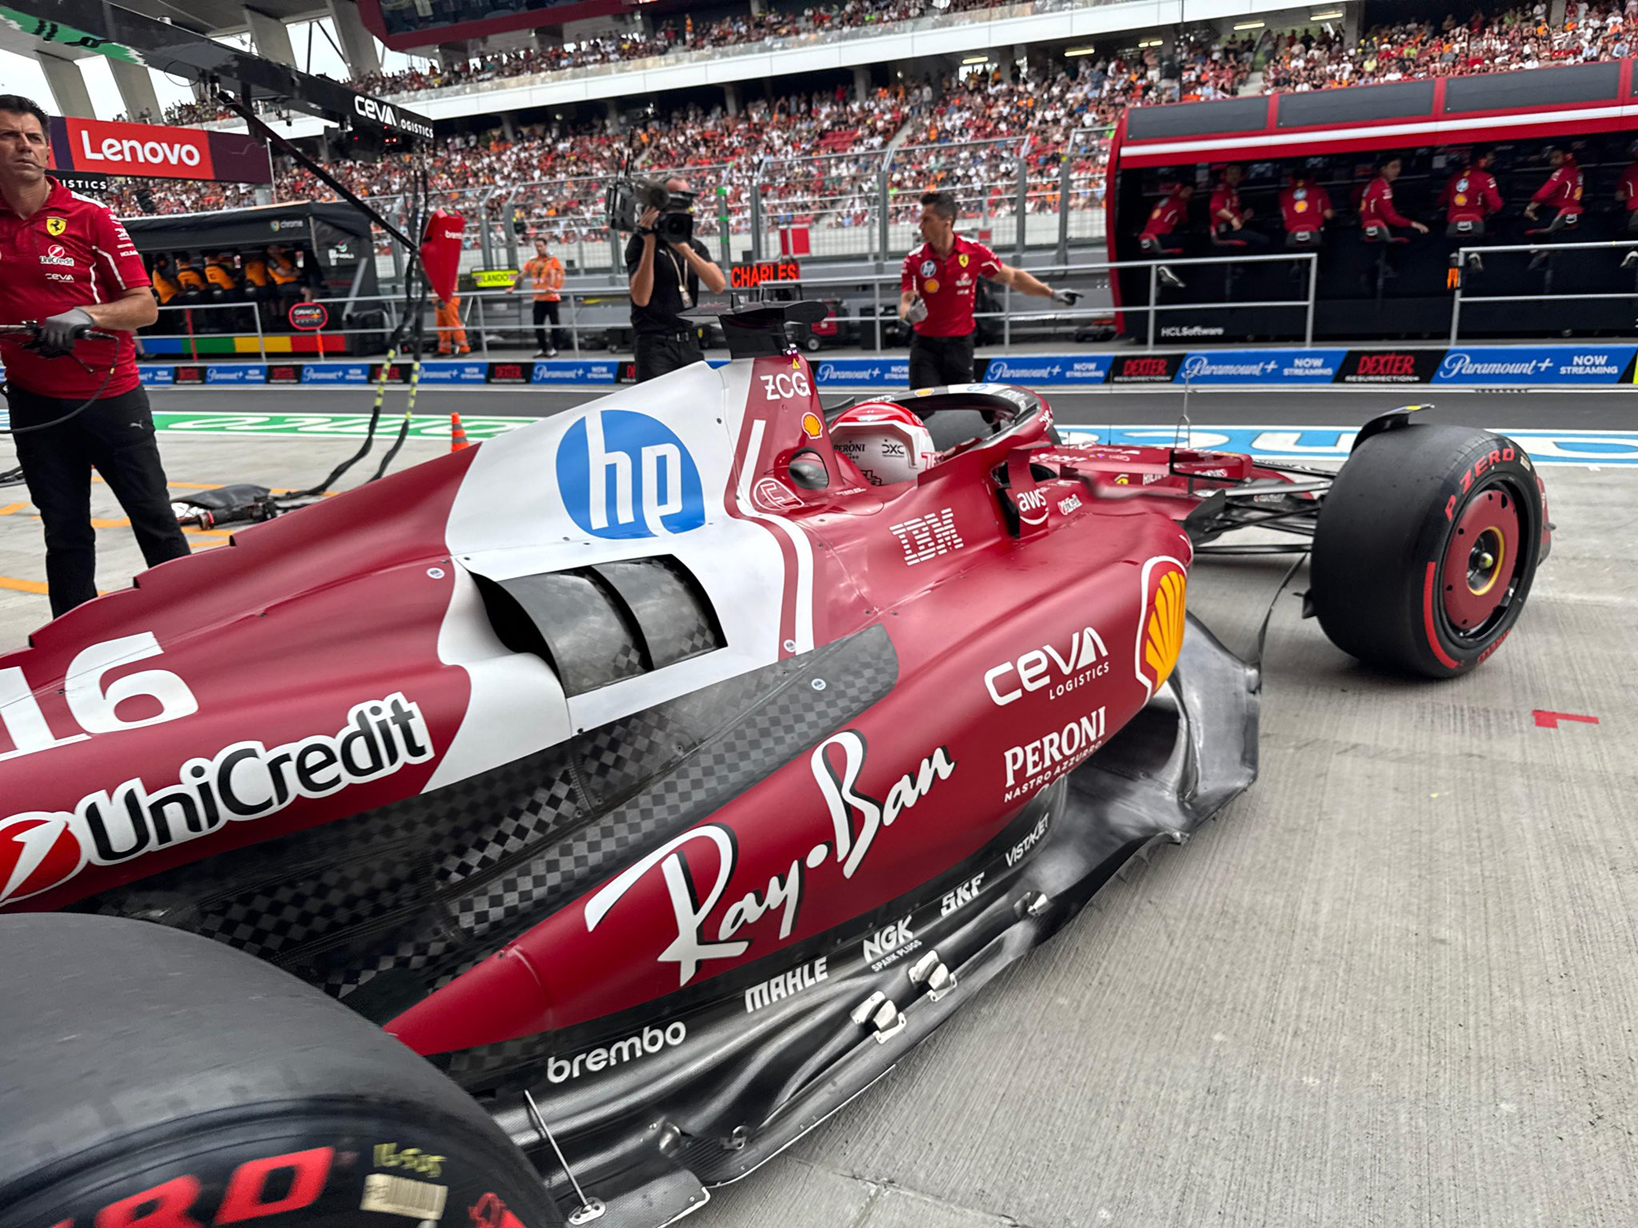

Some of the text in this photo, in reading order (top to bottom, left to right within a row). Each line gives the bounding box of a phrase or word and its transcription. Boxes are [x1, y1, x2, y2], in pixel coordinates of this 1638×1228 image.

[400, 119, 434, 138] OGISTICS
[81, 130, 200, 166] Lenovo
[60, 179, 107, 189] ISTICS
[482, 274, 509, 283] LANDO
[730, 263, 798, 288] CHARLES
[1161, 326, 1224, 337] HCLSoftware
[987, 361, 1062, 382] Paramount+
[1073, 362, 1097, 371] NOW
[1123, 358, 1167, 376] DEXTER
[1181, 355, 1278, 379] Paramount+
[1282, 367, 1333, 376] STREAMING
[1294, 358, 1324, 367] NOW
[1357, 352, 1415, 375] DEXTER
[1439, 353, 1554, 379] Paramount+
[1559, 366, 1618, 375] STREAMING
[1572, 355, 1608, 365] NOW
[816, 364, 880, 382] Paramount+
[760, 372, 811, 400] ZCG
[882, 443, 904, 455] DXC
[580, 409, 690, 538] hp
[1460, 447, 1515, 494] ZERO
[1017, 488, 1047, 512] aws
[889, 507, 964, 566] IBM
[1049, 661, 1110, 700] LOGISTICS
[0, 631, 199, 761] 16
[1003, 706, 1106, 788] PERONI
[83, 696, 431, 863] UniCredit
[1004, 740, 1102, 802] NASTRO AZZURRO
[941, 872, 985, 916] SKF
[863, 915, 914, 963] NGK
[871, 940, 922, 972] SPARK PLUGS
[745, 956, 829, 1013] MAHLE
[547, 1021, 686, 1083] brembo
